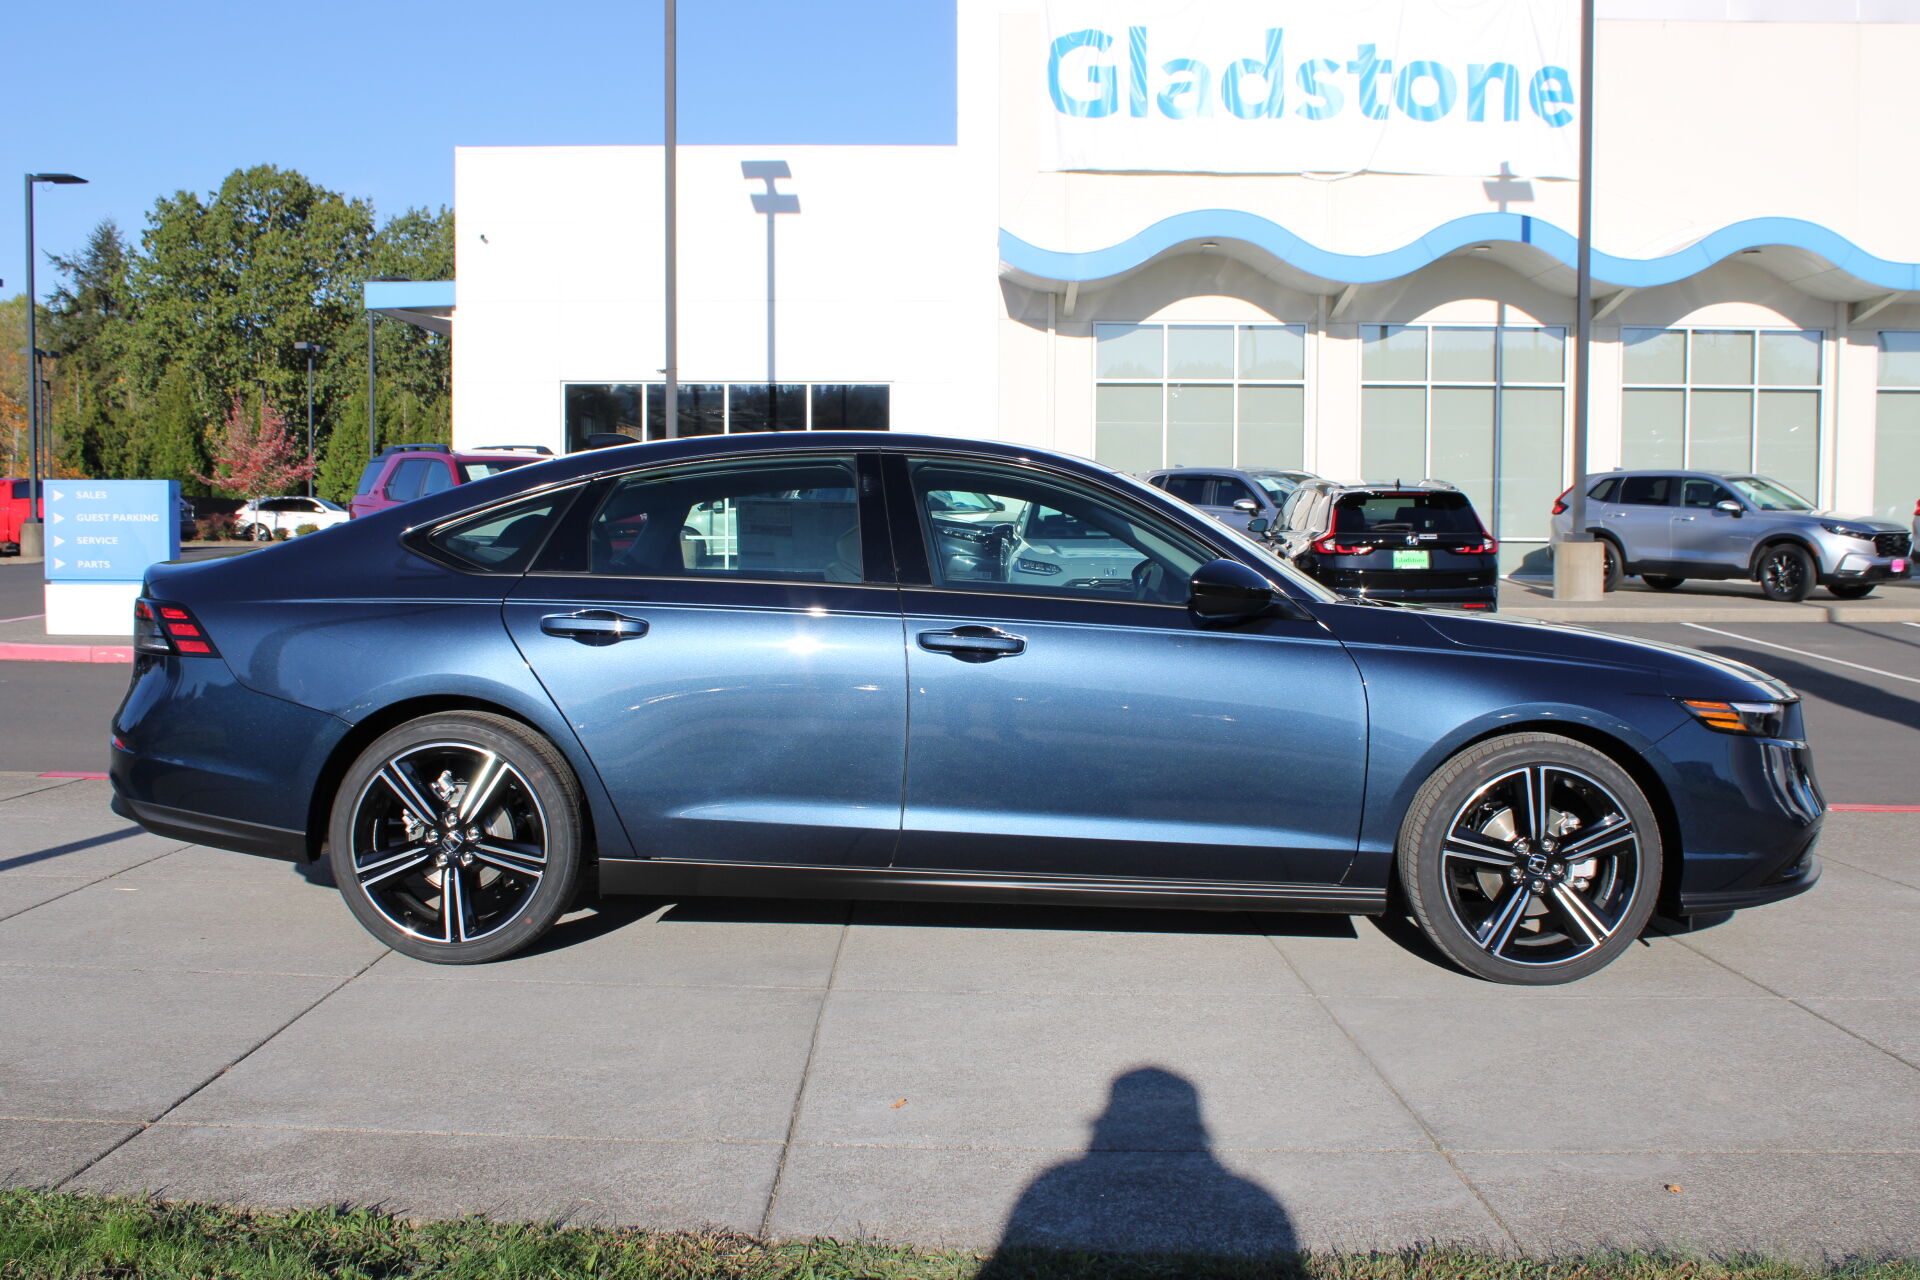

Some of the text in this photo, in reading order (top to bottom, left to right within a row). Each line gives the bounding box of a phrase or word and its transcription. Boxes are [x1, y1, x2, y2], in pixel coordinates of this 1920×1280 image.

[1047, 25, 1574, 128] Gladstone
[75, 491, 107, 499] SALES
[76, 513, 159, 522] GUEST PARKING
[77, 536, 118, 545] SERVICE
[77, 560, 111, 569] PARTS
